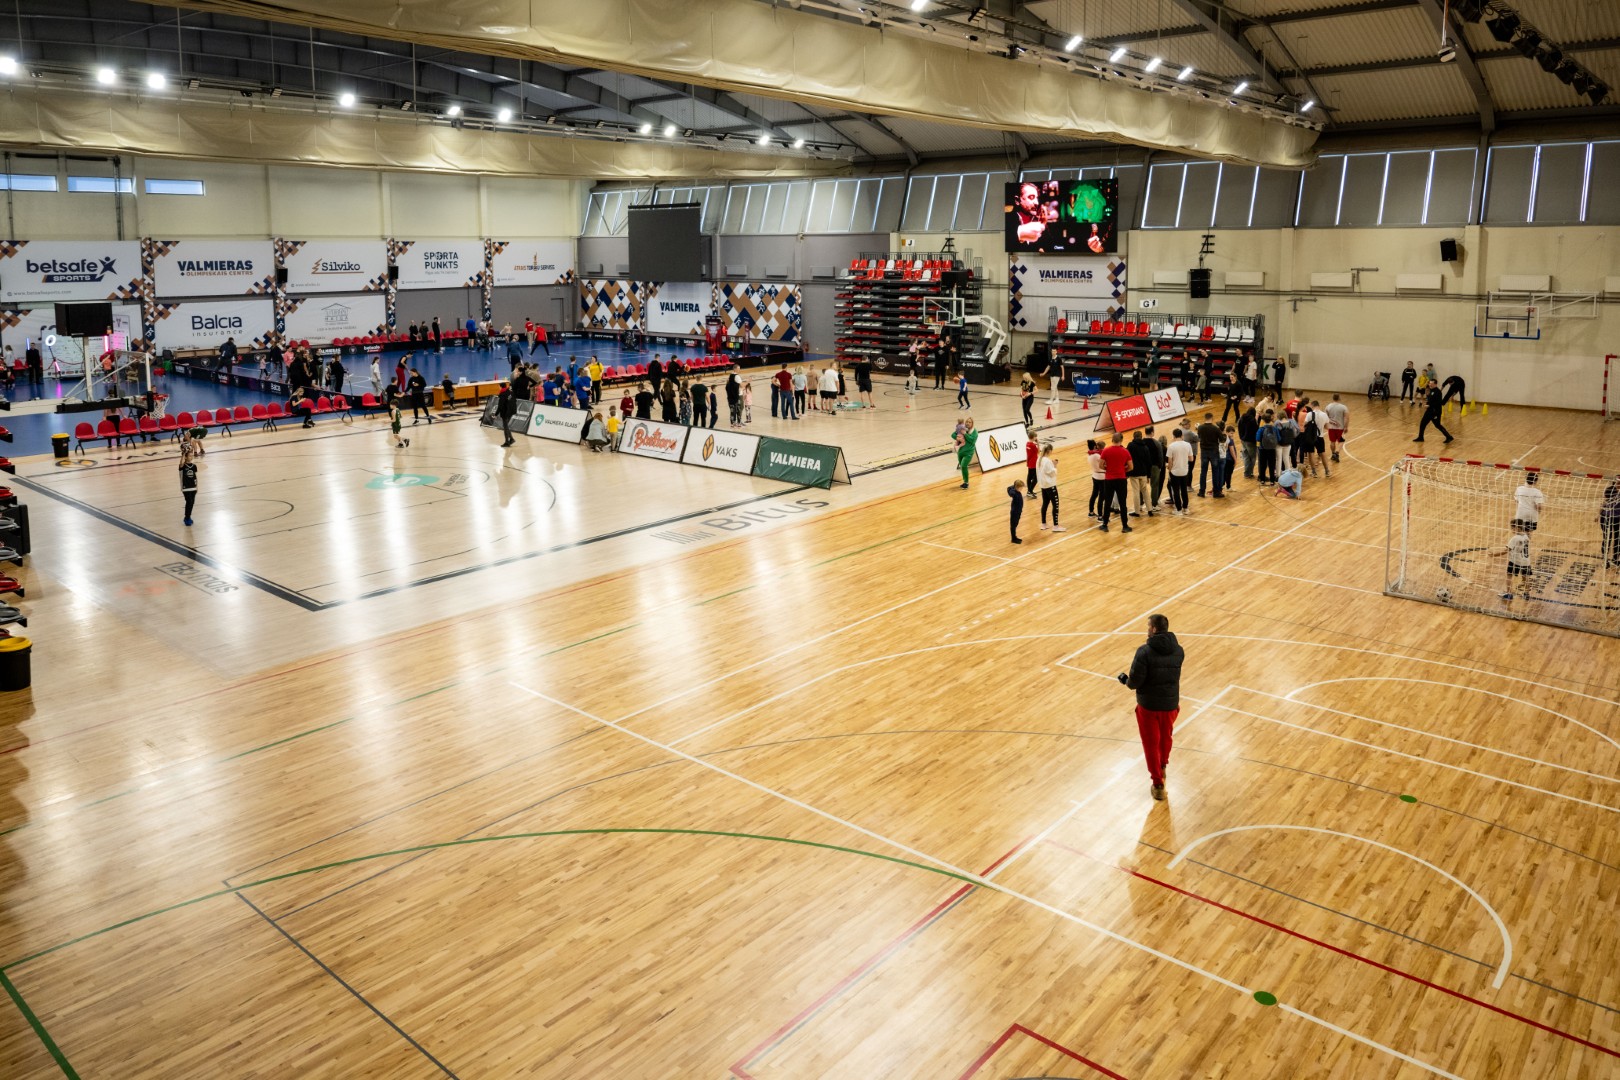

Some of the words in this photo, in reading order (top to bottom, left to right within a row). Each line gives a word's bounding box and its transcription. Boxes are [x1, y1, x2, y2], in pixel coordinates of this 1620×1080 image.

[423, 251, 459, 260] SPORTA
[26, 259, 98, 273] betsafe
[177, 260, 254, 272] VALMIERAS
[321, 261, 361, 272] Silviko
[424, 261, 459, 270] PUNKTS
[1038, 269, 1093, 279] VALMIERAS
[660, 301, 701, 313] VALMIERA
[1142, 300, 1150, 308] G
[191, 315, 243, 330] Balcia
[192, 329, 244, 337] insurance
[715, 445, 738, 458] VAKS
[1000, 440, 1018, 452] VAKS
[770, 451, 821, 472] VALMIERA
[700, 498, 830, 532] Bitus
